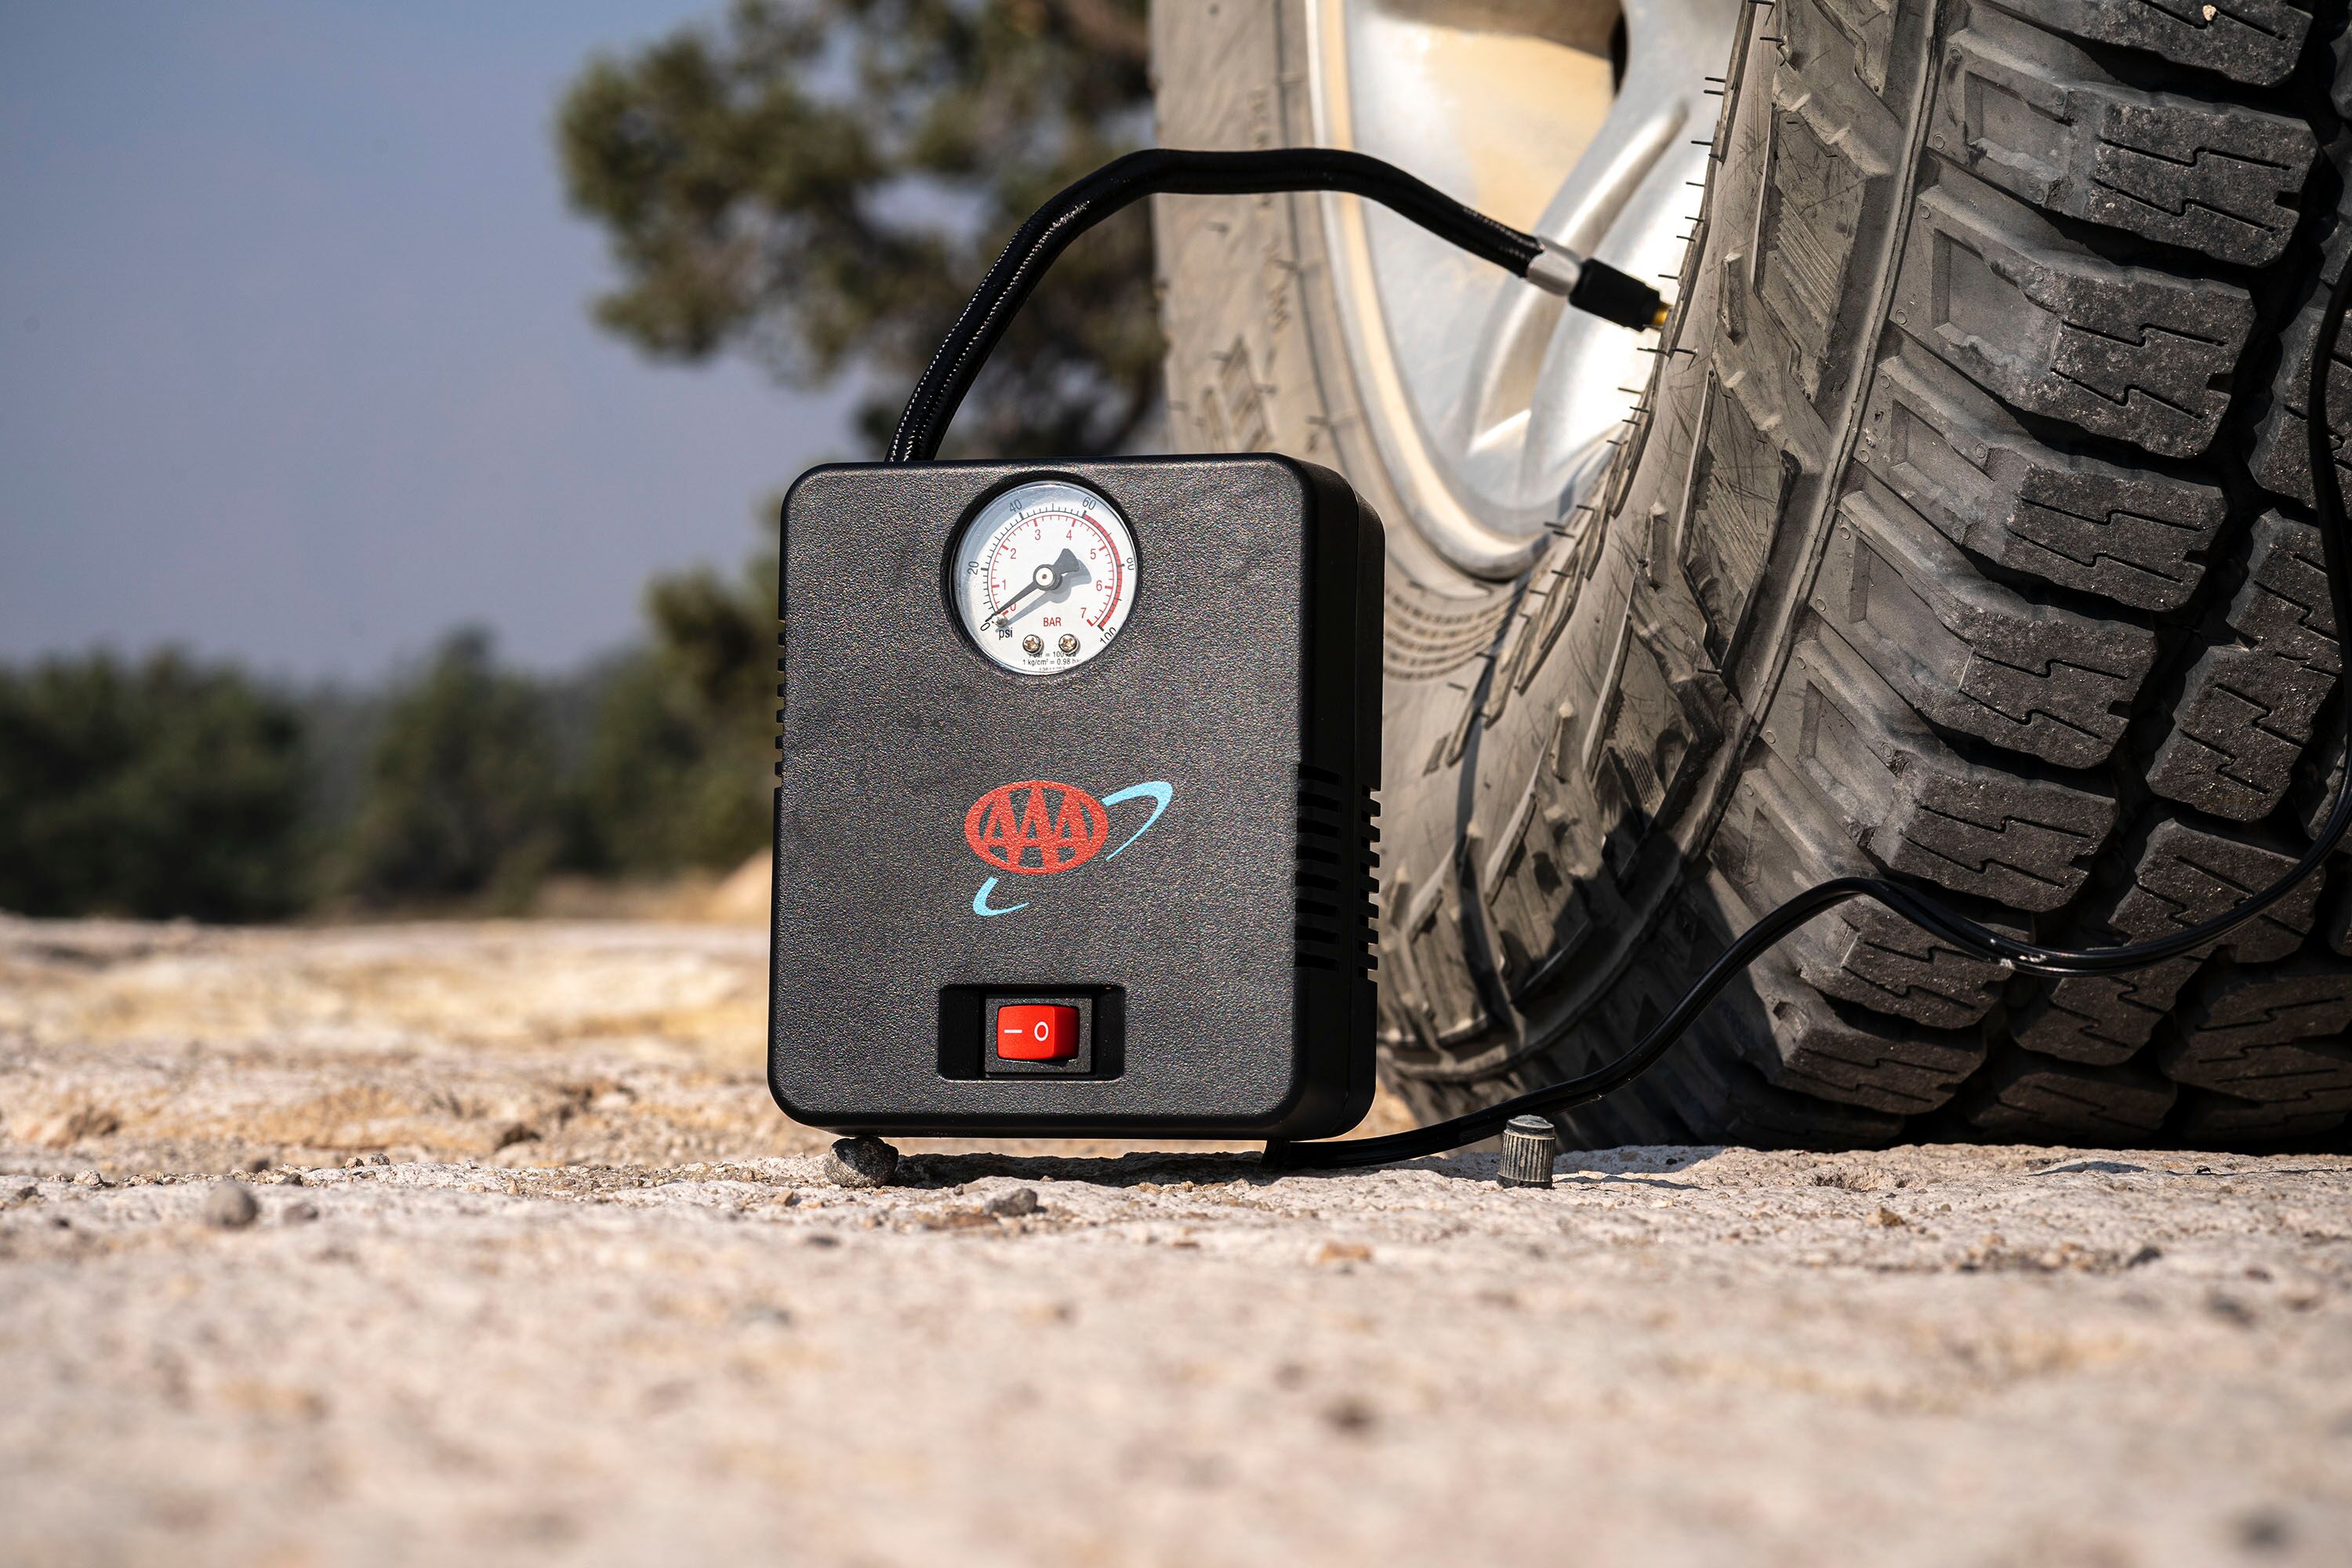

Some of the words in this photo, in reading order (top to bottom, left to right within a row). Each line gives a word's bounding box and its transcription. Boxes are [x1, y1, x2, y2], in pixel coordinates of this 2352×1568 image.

[1009, 499, 1022, 513] 40
[1082, 496, 1097, 510] 60
[1034, 529, 1041, 540] 3
[1065, 530, 1073, 540] 4
[1010, 548, 1017, 560] 2
[1090, 549, 1096, 560] 5
[967, 561, 979, 575] 20
[1002, 579, 1007, 590] 1
[1096, 580, 1102, 591] 6
[1080, 608, 1087, 619] 7
[980, 622, 991, 631] 0
[1043, 617, 1062, 627] BAR
[999, 627, 1013, 641] psi
[1099, 627, 1116, 644] 100
[971, 782, 1104, 873] AAA
